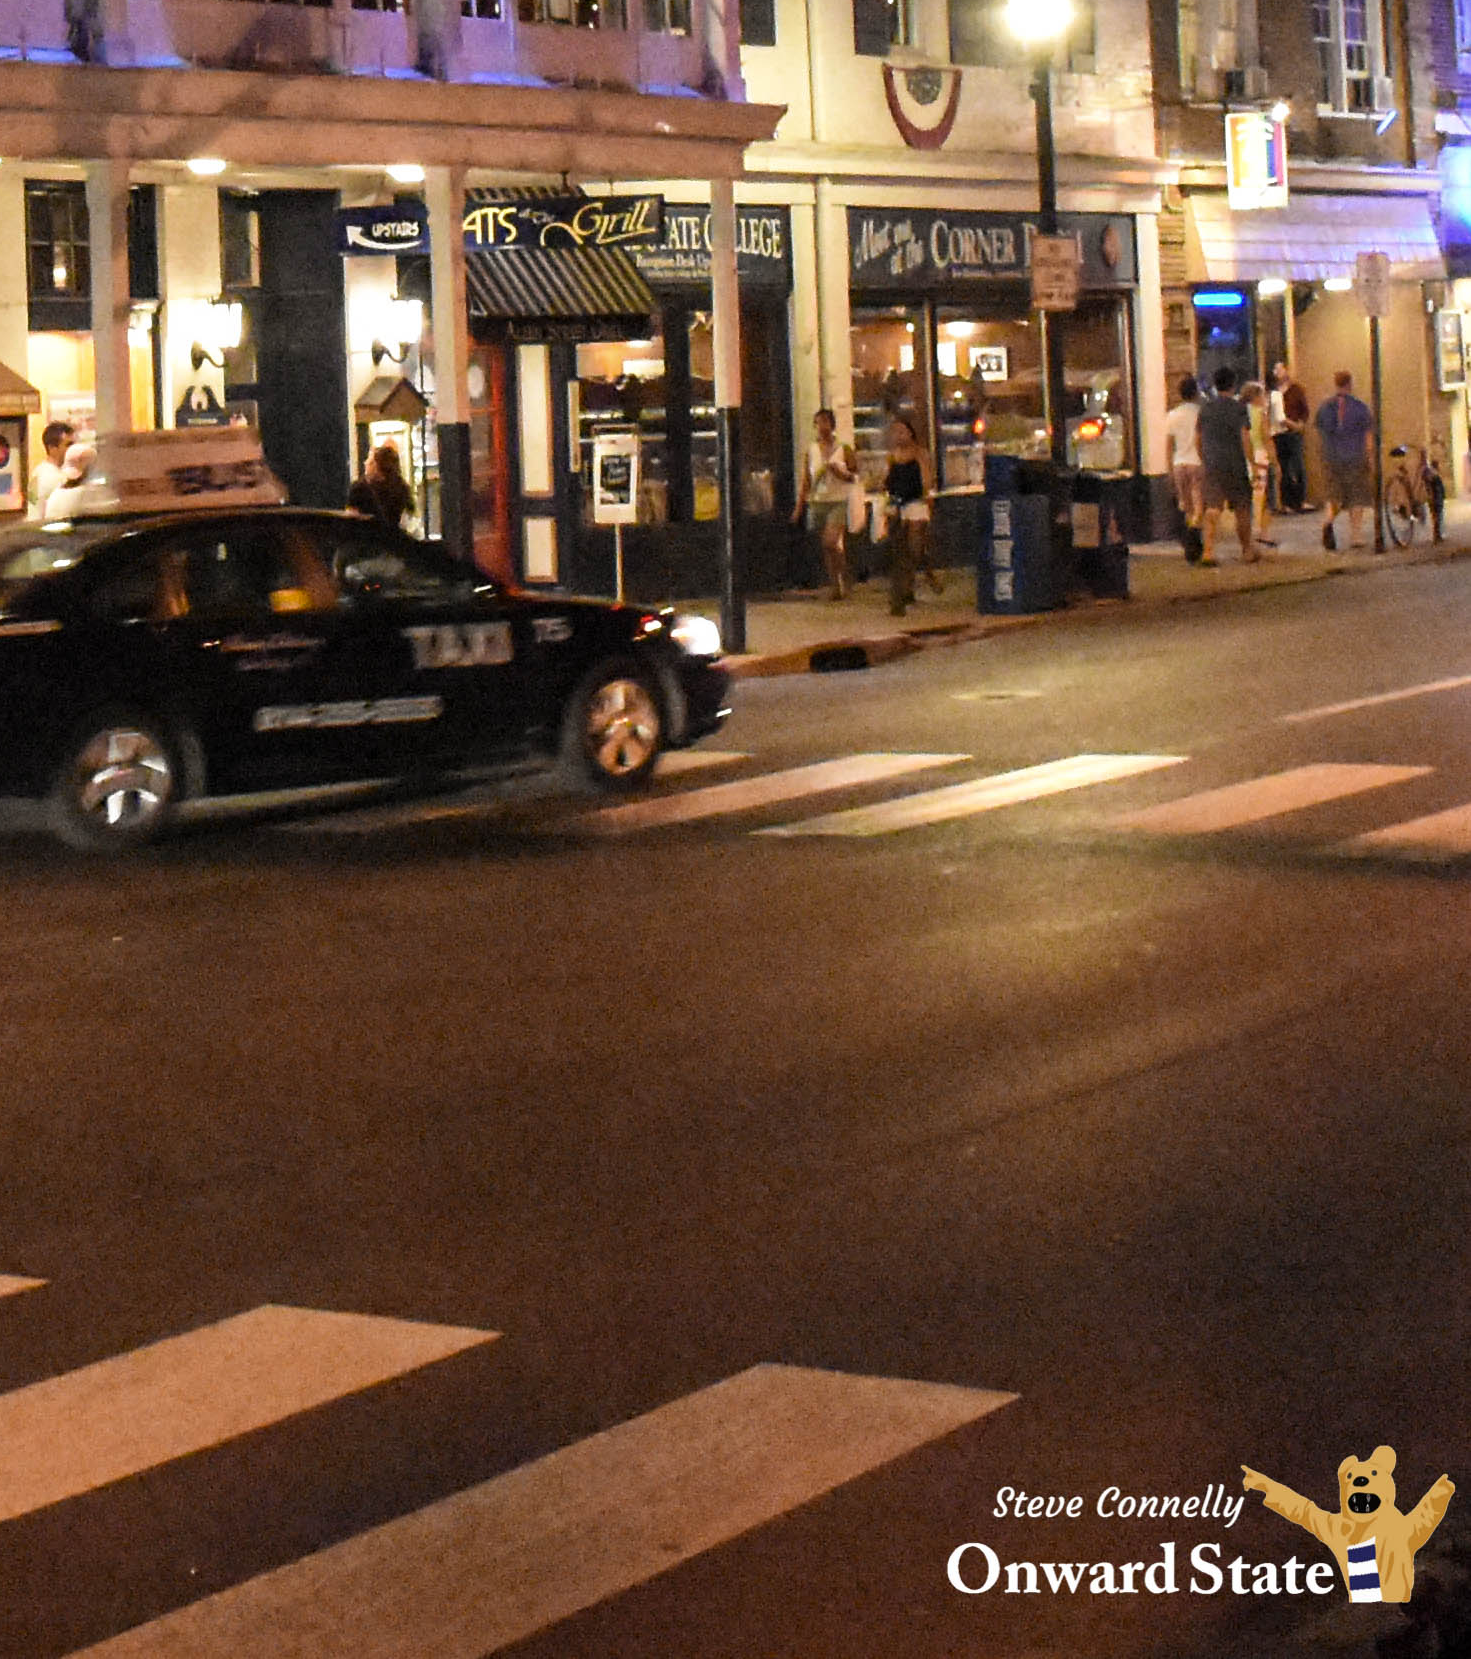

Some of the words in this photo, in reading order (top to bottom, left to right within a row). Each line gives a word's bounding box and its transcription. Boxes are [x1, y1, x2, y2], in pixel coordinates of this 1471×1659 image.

[371, 219, 420, 238] UPSTAIRS
[540, 202, 657, 246] Grill
[930, 219, 1016, 269] CORNER
